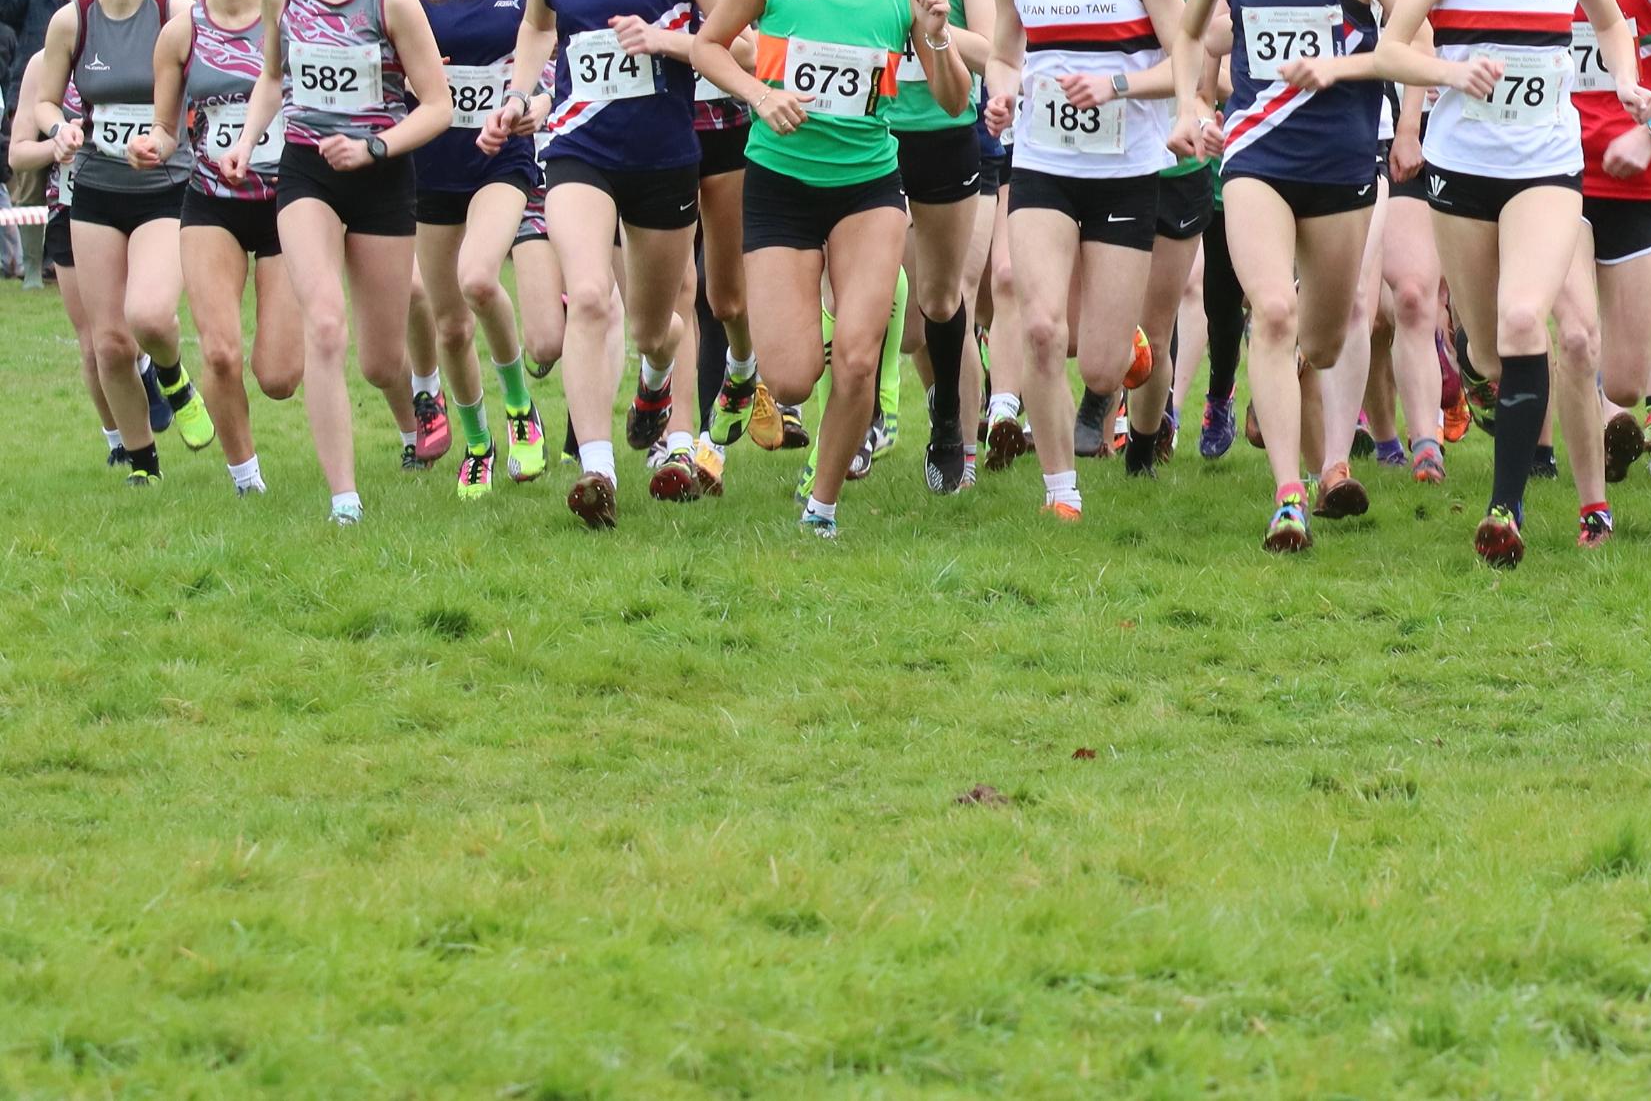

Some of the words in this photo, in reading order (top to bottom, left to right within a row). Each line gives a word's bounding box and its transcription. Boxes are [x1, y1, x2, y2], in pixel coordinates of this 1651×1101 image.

[1022, 4, 1045, 15] AFAN
[1050, 4, 1080, 16] NEDD
[1086, 3, 1118, 14] TAWE
[1256, 30, 1321, 61] 373
[301, 63, 359, 92] 582
[579, 52, 640, 83] 374
[794, 62, 860, 97] 673
[1045, 100, 1101, 134] 183
[215, 122, 270, 148] 57
